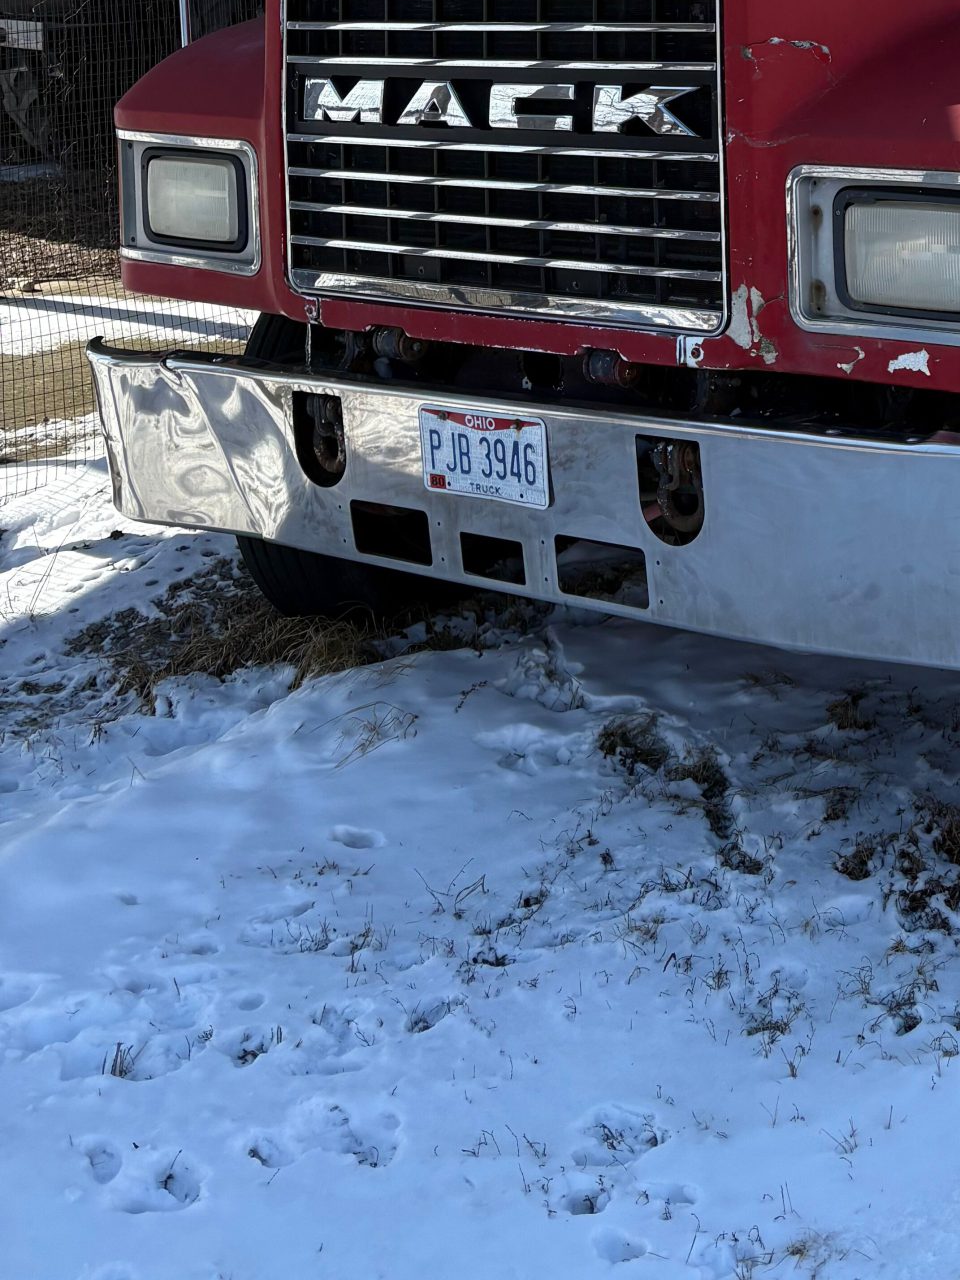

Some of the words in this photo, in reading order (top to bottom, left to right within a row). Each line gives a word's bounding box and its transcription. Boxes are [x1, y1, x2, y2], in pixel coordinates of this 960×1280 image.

[303, 77, 701, 138] MACK
[464, 414, 496, 430] OHIO
[428, 428, 472, 475] PJB
[478, 436, 537, 486] 3946
[469, 481, 502, 495] TRUCK
